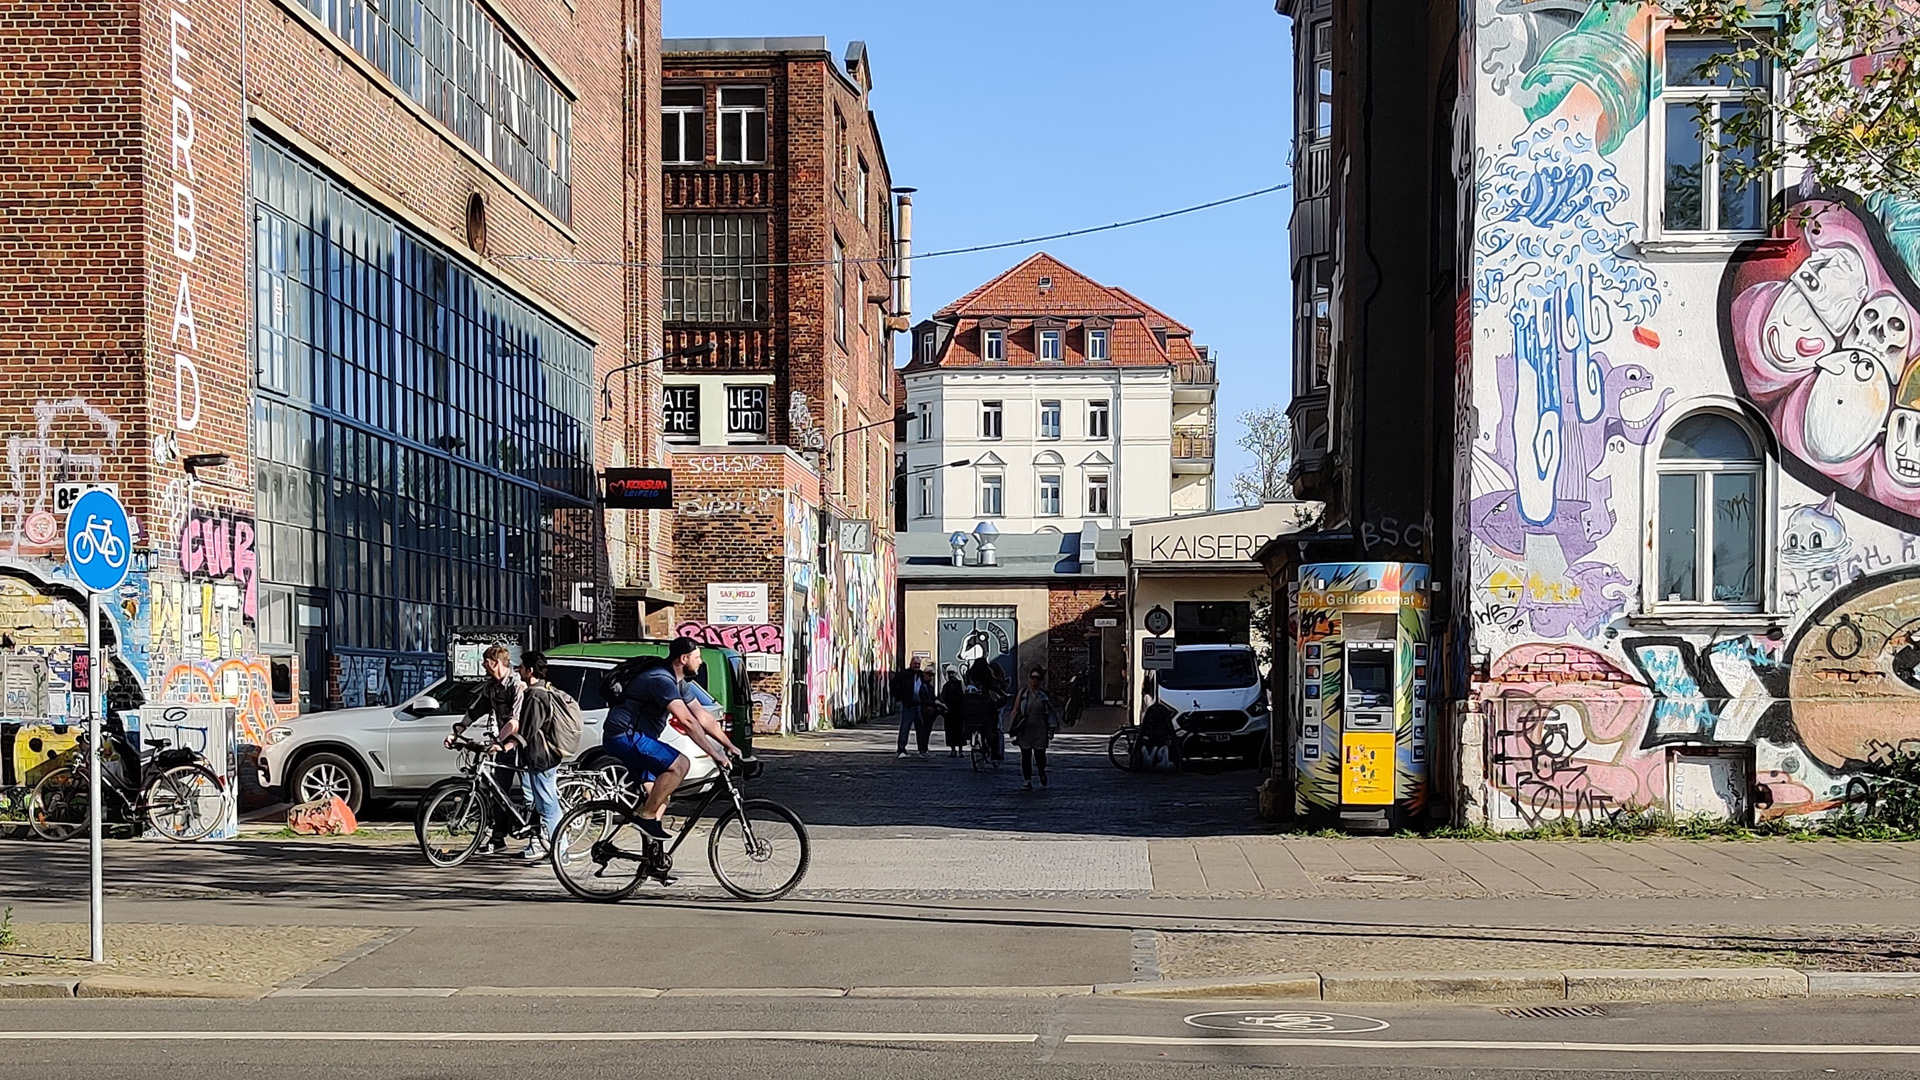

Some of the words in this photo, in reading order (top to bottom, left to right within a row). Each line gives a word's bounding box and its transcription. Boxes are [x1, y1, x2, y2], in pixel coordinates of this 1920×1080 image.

[170, 0, 202, 431] ERBAD
[663, 389, 696, 409] ATE
[729, 389, 764, 409] LIER
[624, 490, 660, 498] LEIPZIG
[1326, 593, 1415, 606] Geldautomat
